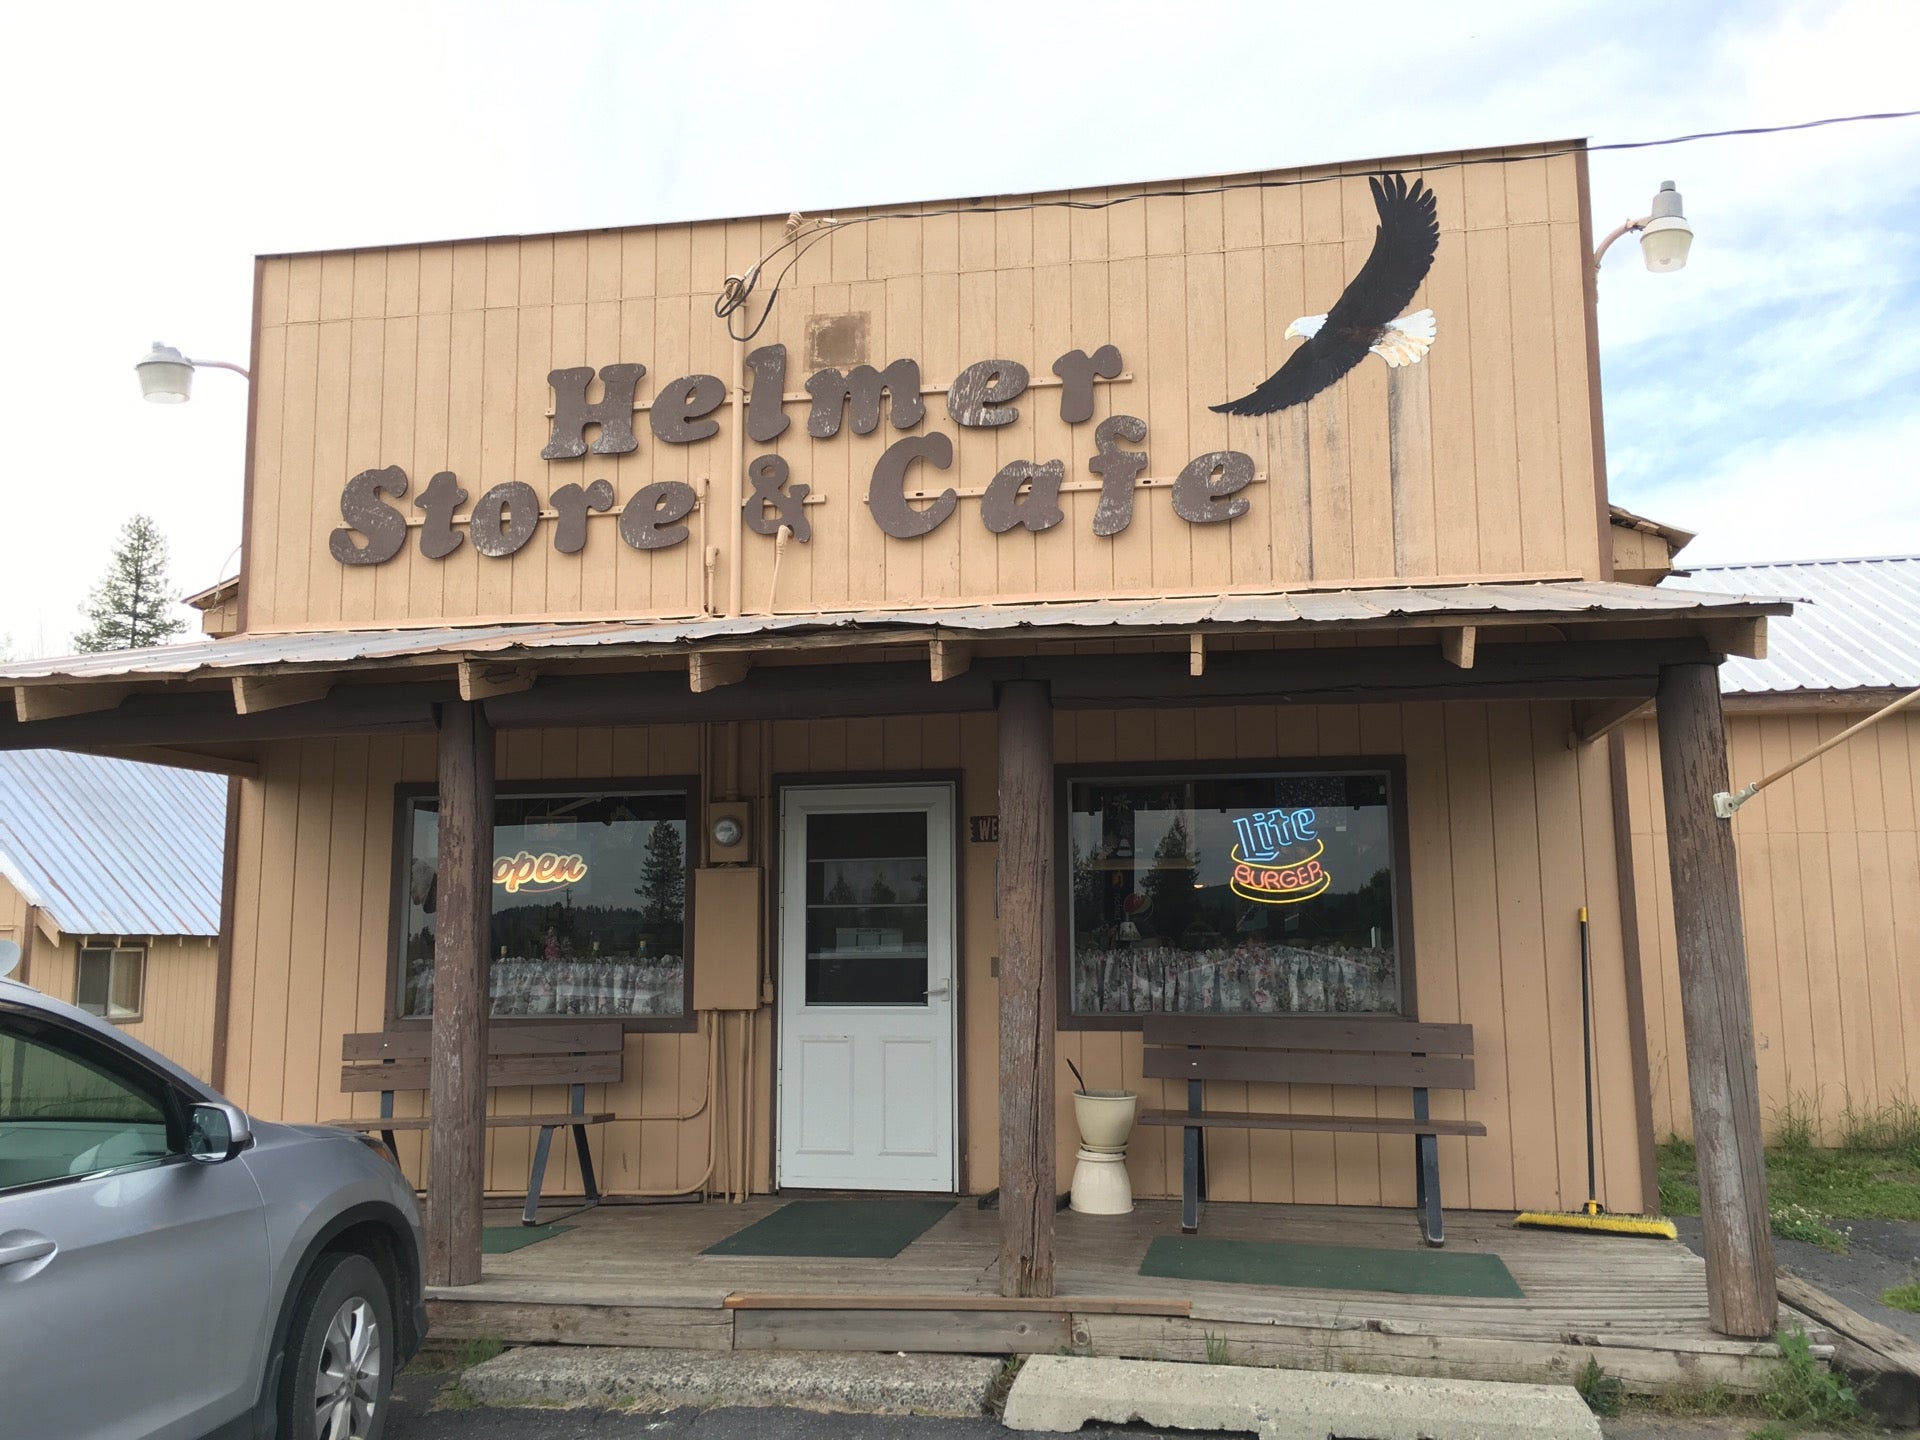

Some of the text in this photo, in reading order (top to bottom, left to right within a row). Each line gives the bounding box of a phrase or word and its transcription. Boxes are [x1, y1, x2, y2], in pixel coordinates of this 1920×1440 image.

[541, 343, 1124, 460] Helmer
[329, 415, 1255, 565] Store & Cafe
[1233, 808, 1319, 862] Lite
[492, 851, 588, 893] open
[1234, 860, 1324, 889] BURGER
